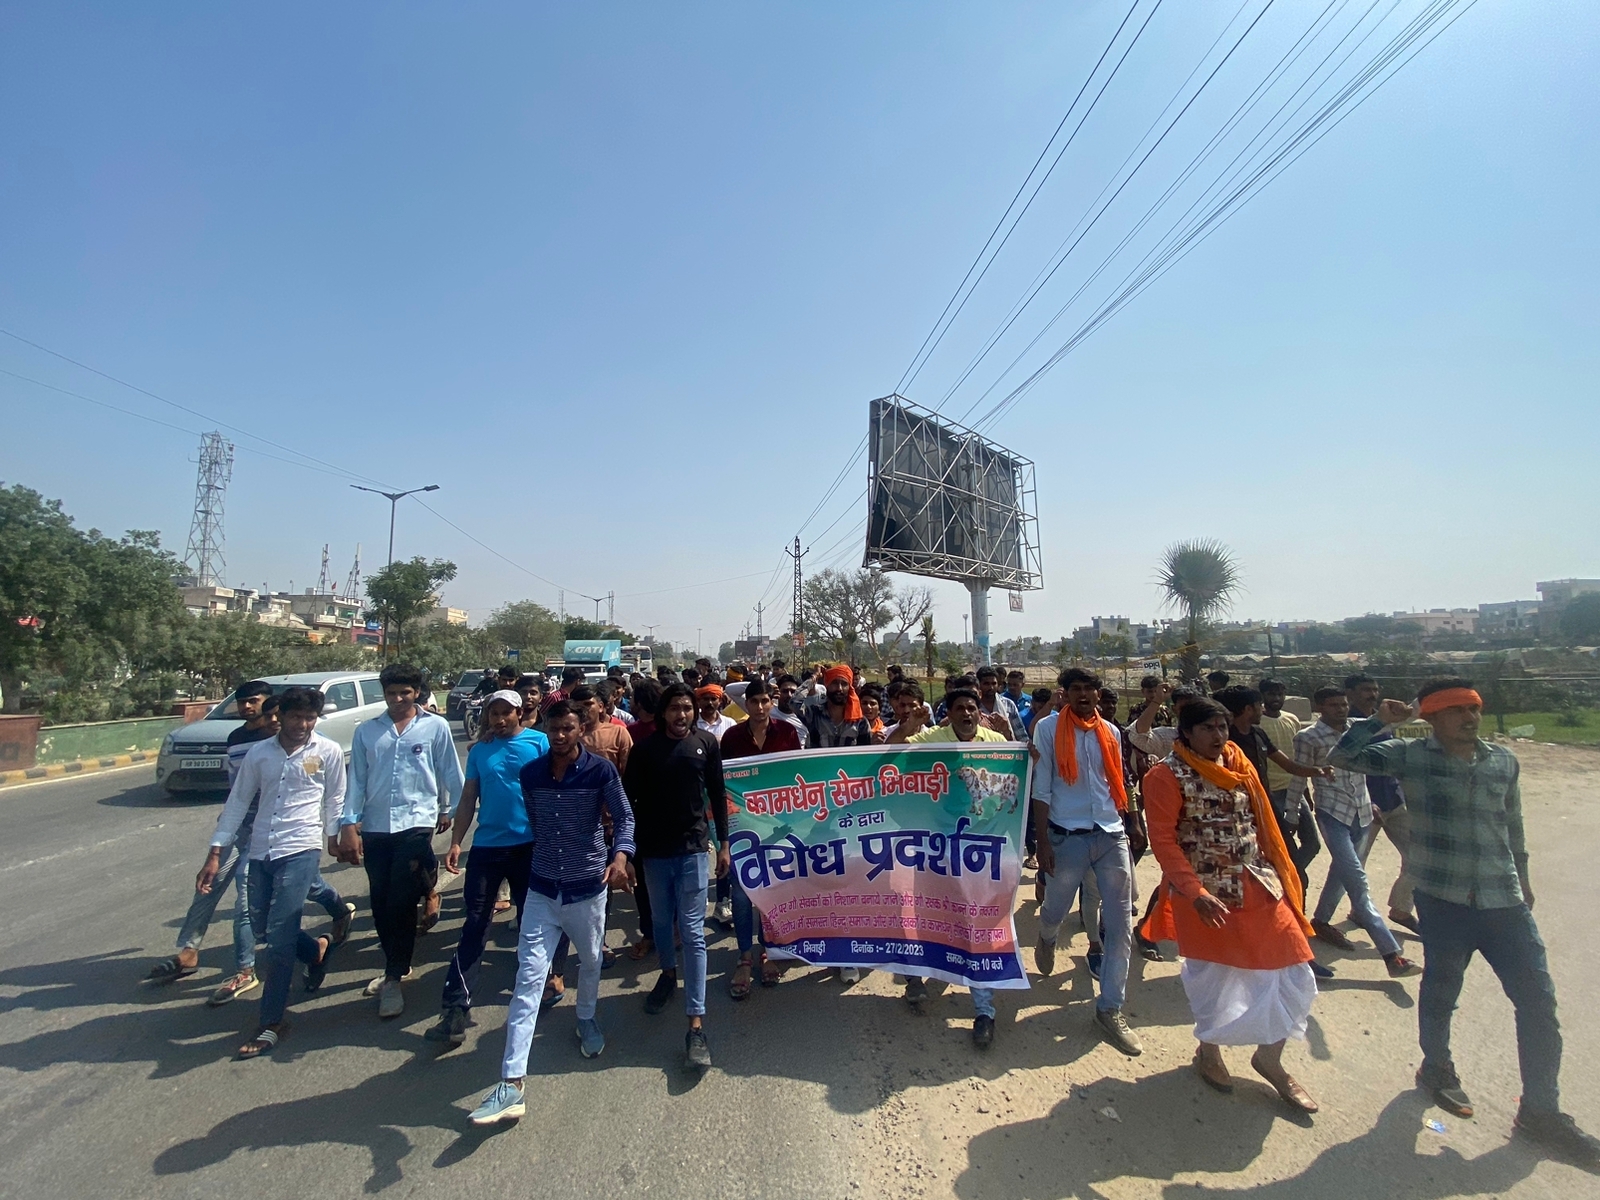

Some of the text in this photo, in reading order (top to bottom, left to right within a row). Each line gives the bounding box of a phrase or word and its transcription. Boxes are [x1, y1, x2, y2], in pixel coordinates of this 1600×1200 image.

[574, 646, 604, 654] GATI
[743, 761, 950, 821] कामधेनु सेना भिवाड़ी
[838, 811, 885, 828] के द्वारा
[730, 816, 1007, 889] विरोध प्रदर्शन
[799, 893, 821, 909] सेवकों
[822, 893, 832, 906] को
[834, 892, 859, 906] निशाना
[882, 892, 898, 905] जाने
[900, 891, 914, 906] और
[805, 916, 828, 928] समस्त
[848, 915, 871, 927] समाज
[873, 913, 886, 928] और
[803, 940, 826, 956] भिवाड़ी
[851, 940, 874, 953] दिनांक
[885, 942, 924, 956] 27/2/2023
[981, 957, 990, 970] 10
[991, 956, 1003, 970] बजे
